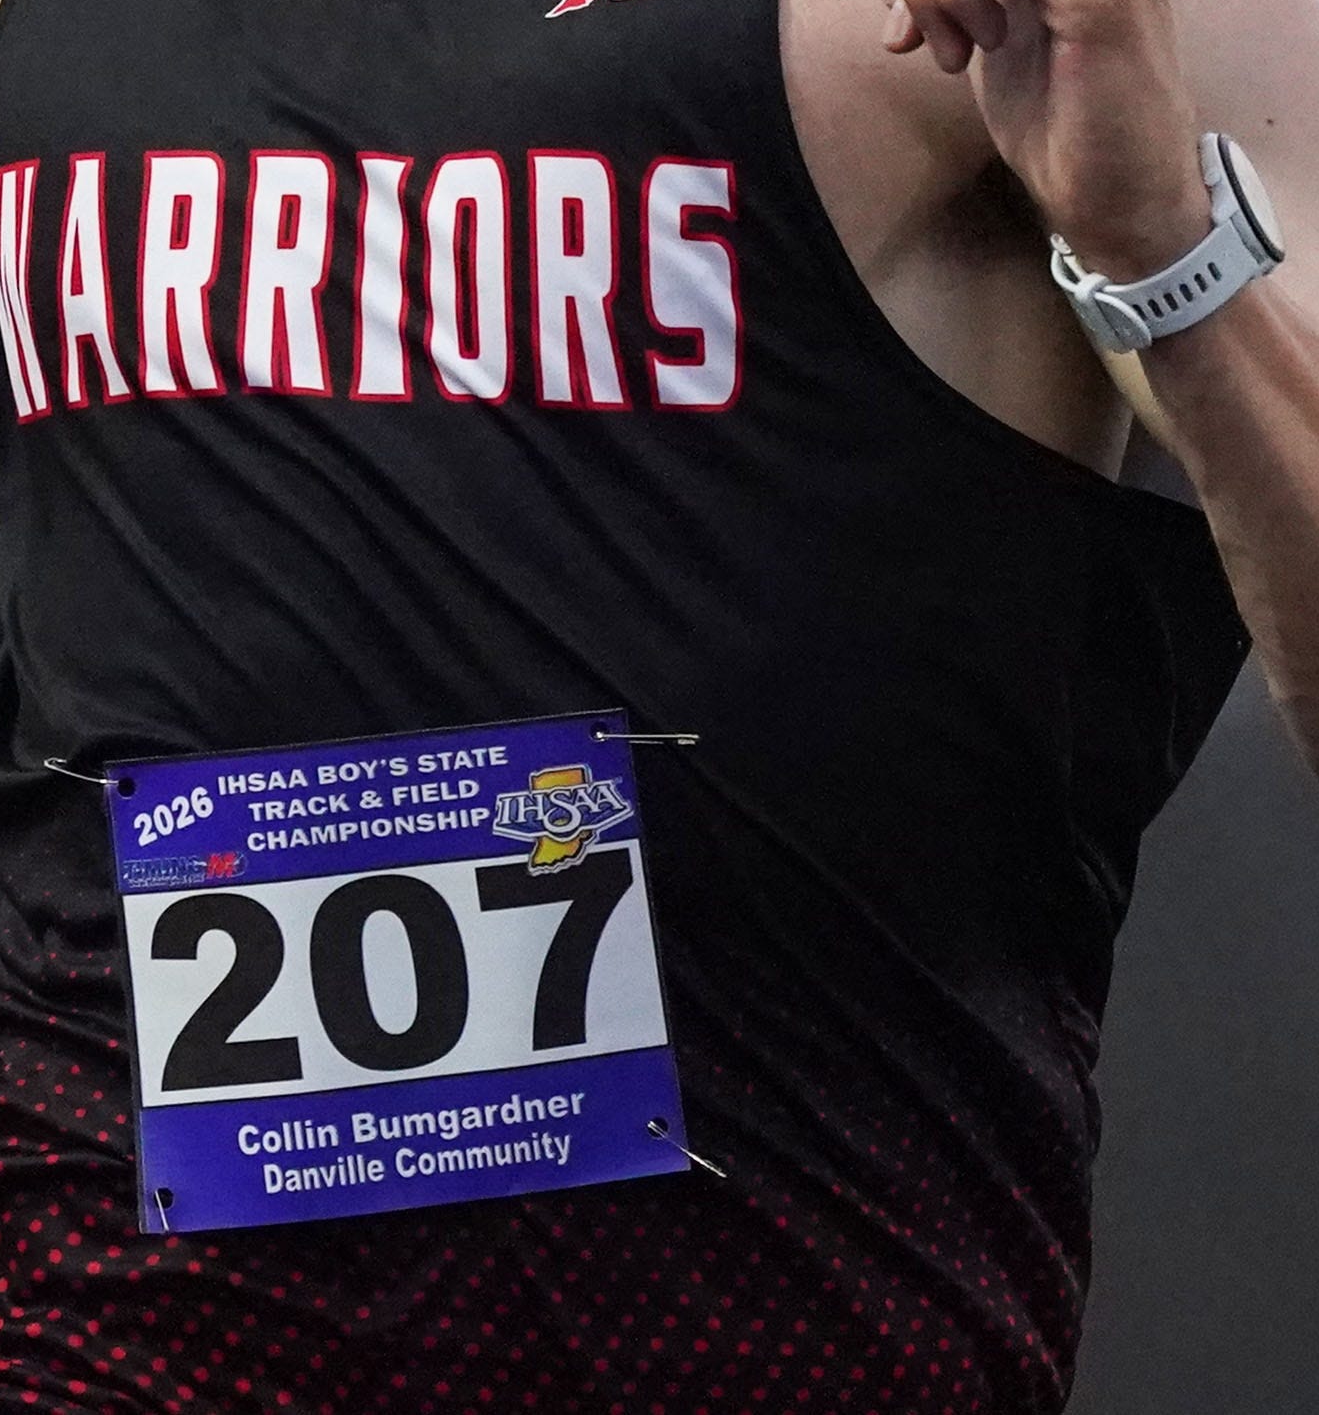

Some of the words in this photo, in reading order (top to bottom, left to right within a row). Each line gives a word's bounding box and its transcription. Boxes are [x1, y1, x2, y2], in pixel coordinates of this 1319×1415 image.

[217, 768, 309, 796] IHSAA
[317, 757, 409, 785] BOY'S
[417, 746, 509, 773] STATE
[133, 786, 215, 847] 2026
[248, 793, 350, 822] TRACK
[359, 790, 383, 810] &
[392, 779, 480, 807] FIELD
[496, 781, 626, 834] IHSAA
[247, 807, 491, 852] CHAMPIONSHIP
[150, 848, 634, 1092] 207
[237, 1120, 340, 1156] Collin
[351, 1091, 586, 1144] Bumgardner
[263, 1153, 386, 1194] Danville
[395, 1132, 572, 1180] Community
